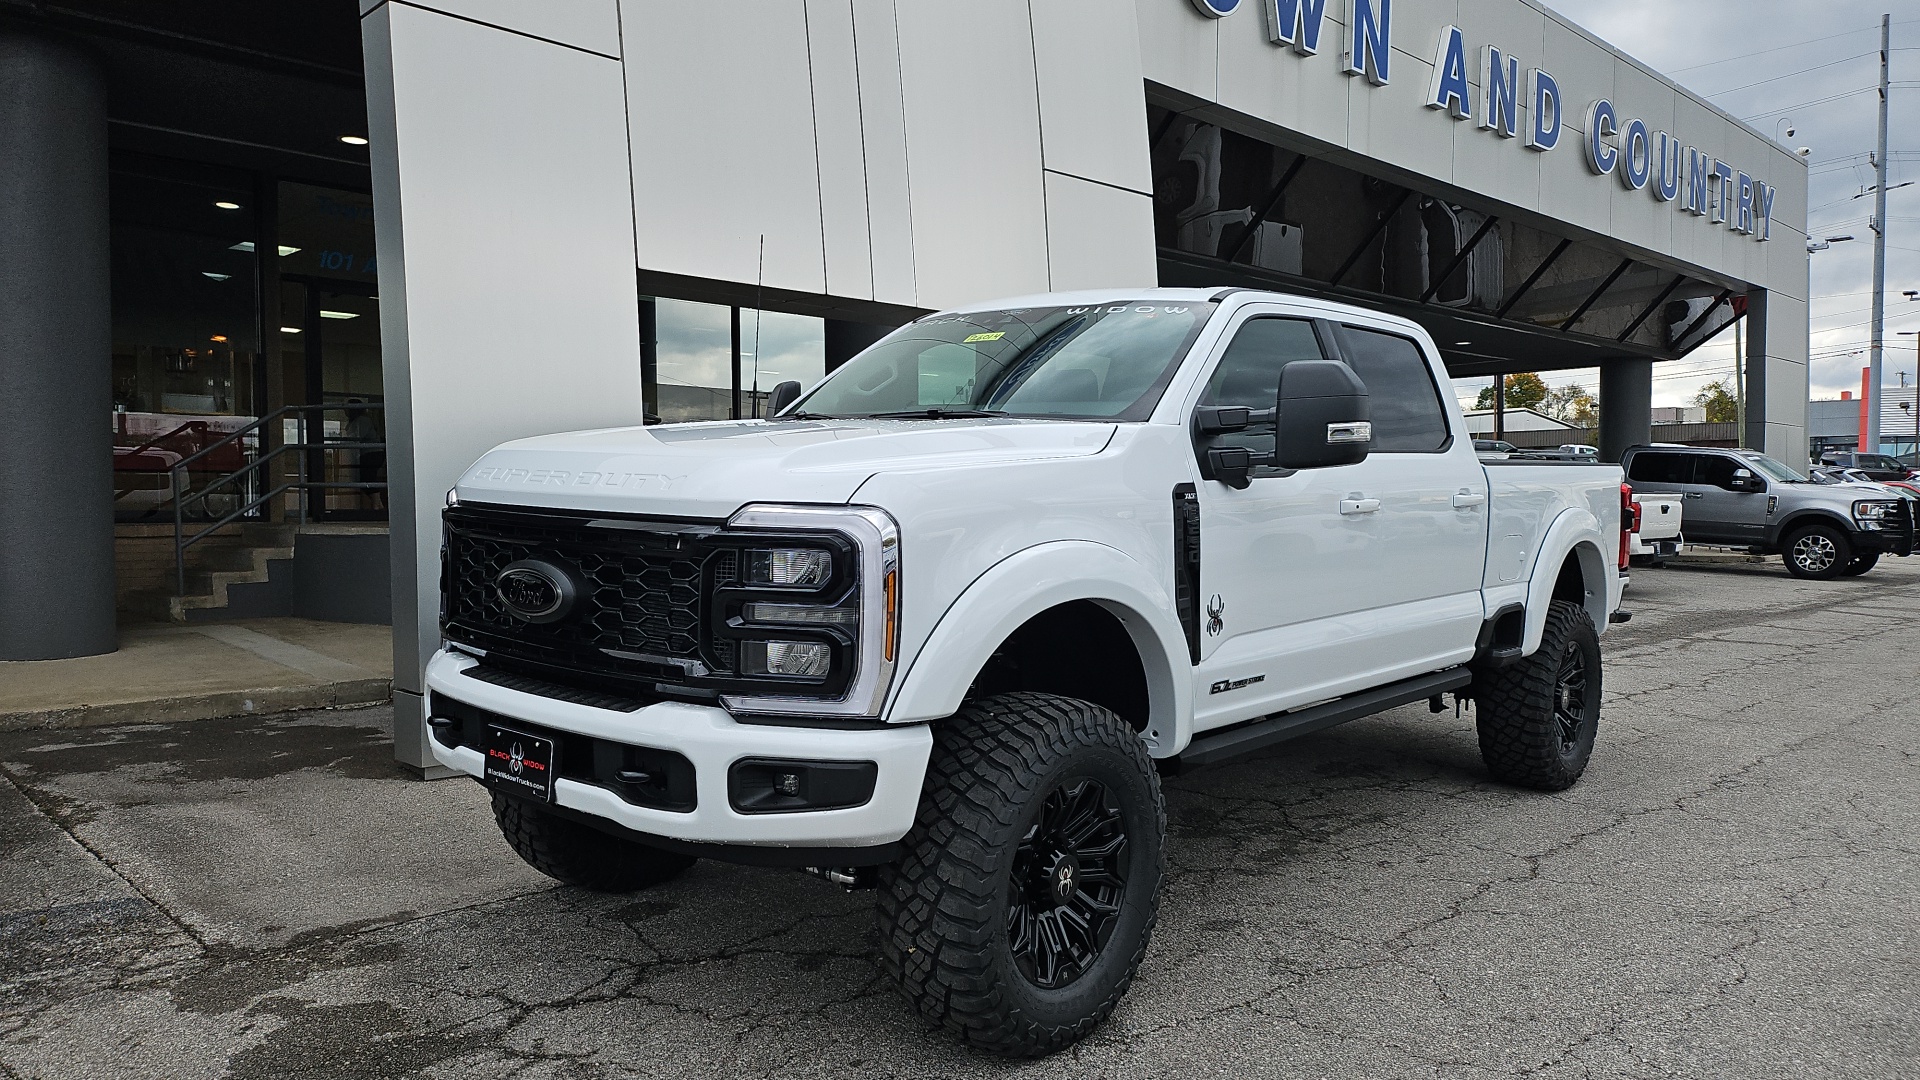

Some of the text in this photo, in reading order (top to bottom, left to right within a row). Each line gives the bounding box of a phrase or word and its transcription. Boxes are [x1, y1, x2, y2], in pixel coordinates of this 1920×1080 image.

[1427, 24, 1562, 152] AND
[1584, 98, 1777, 242] COUNTRY
[319, 250, 354, 272] 101
[1066, 304, 1189, 316] WIDOW
[472, 466, 688, 491] SUPER DUTY
[489, 748, 545, 771] BLACK WIDOW
[487, 767, 546, 791] BlackWidowTrucks.com
